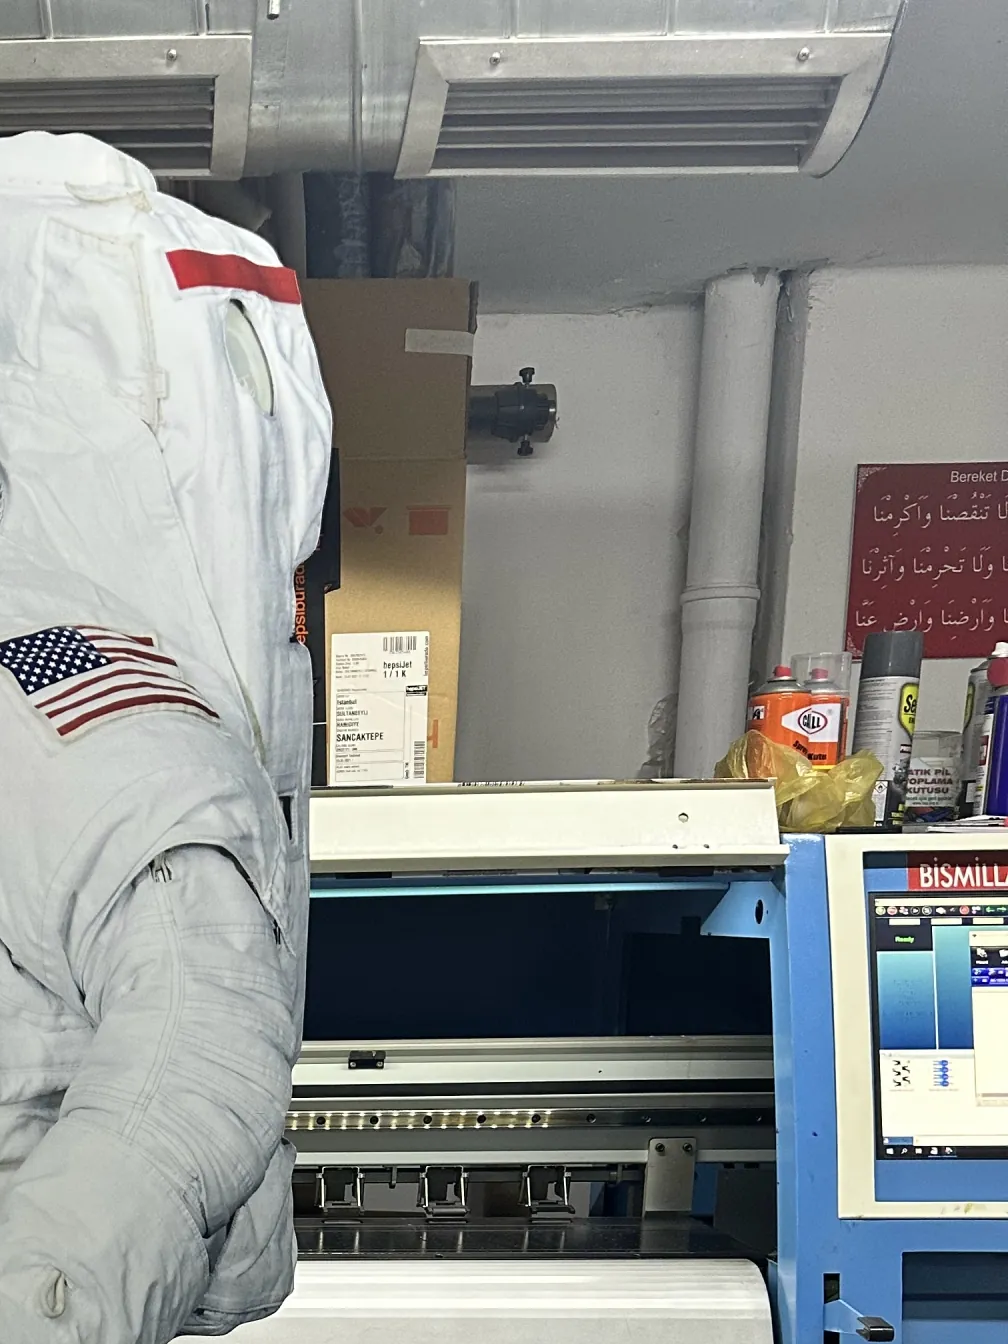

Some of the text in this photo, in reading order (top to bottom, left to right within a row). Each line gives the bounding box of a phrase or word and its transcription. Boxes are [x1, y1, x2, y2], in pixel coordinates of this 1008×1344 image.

[950, 470, 998, 483] Bereket
[383, 660, 412, 671] hepsiJet
[336, 731, 384, 742] SANCAKTEPE
[906, 786, 950, 794] KUTUSU
